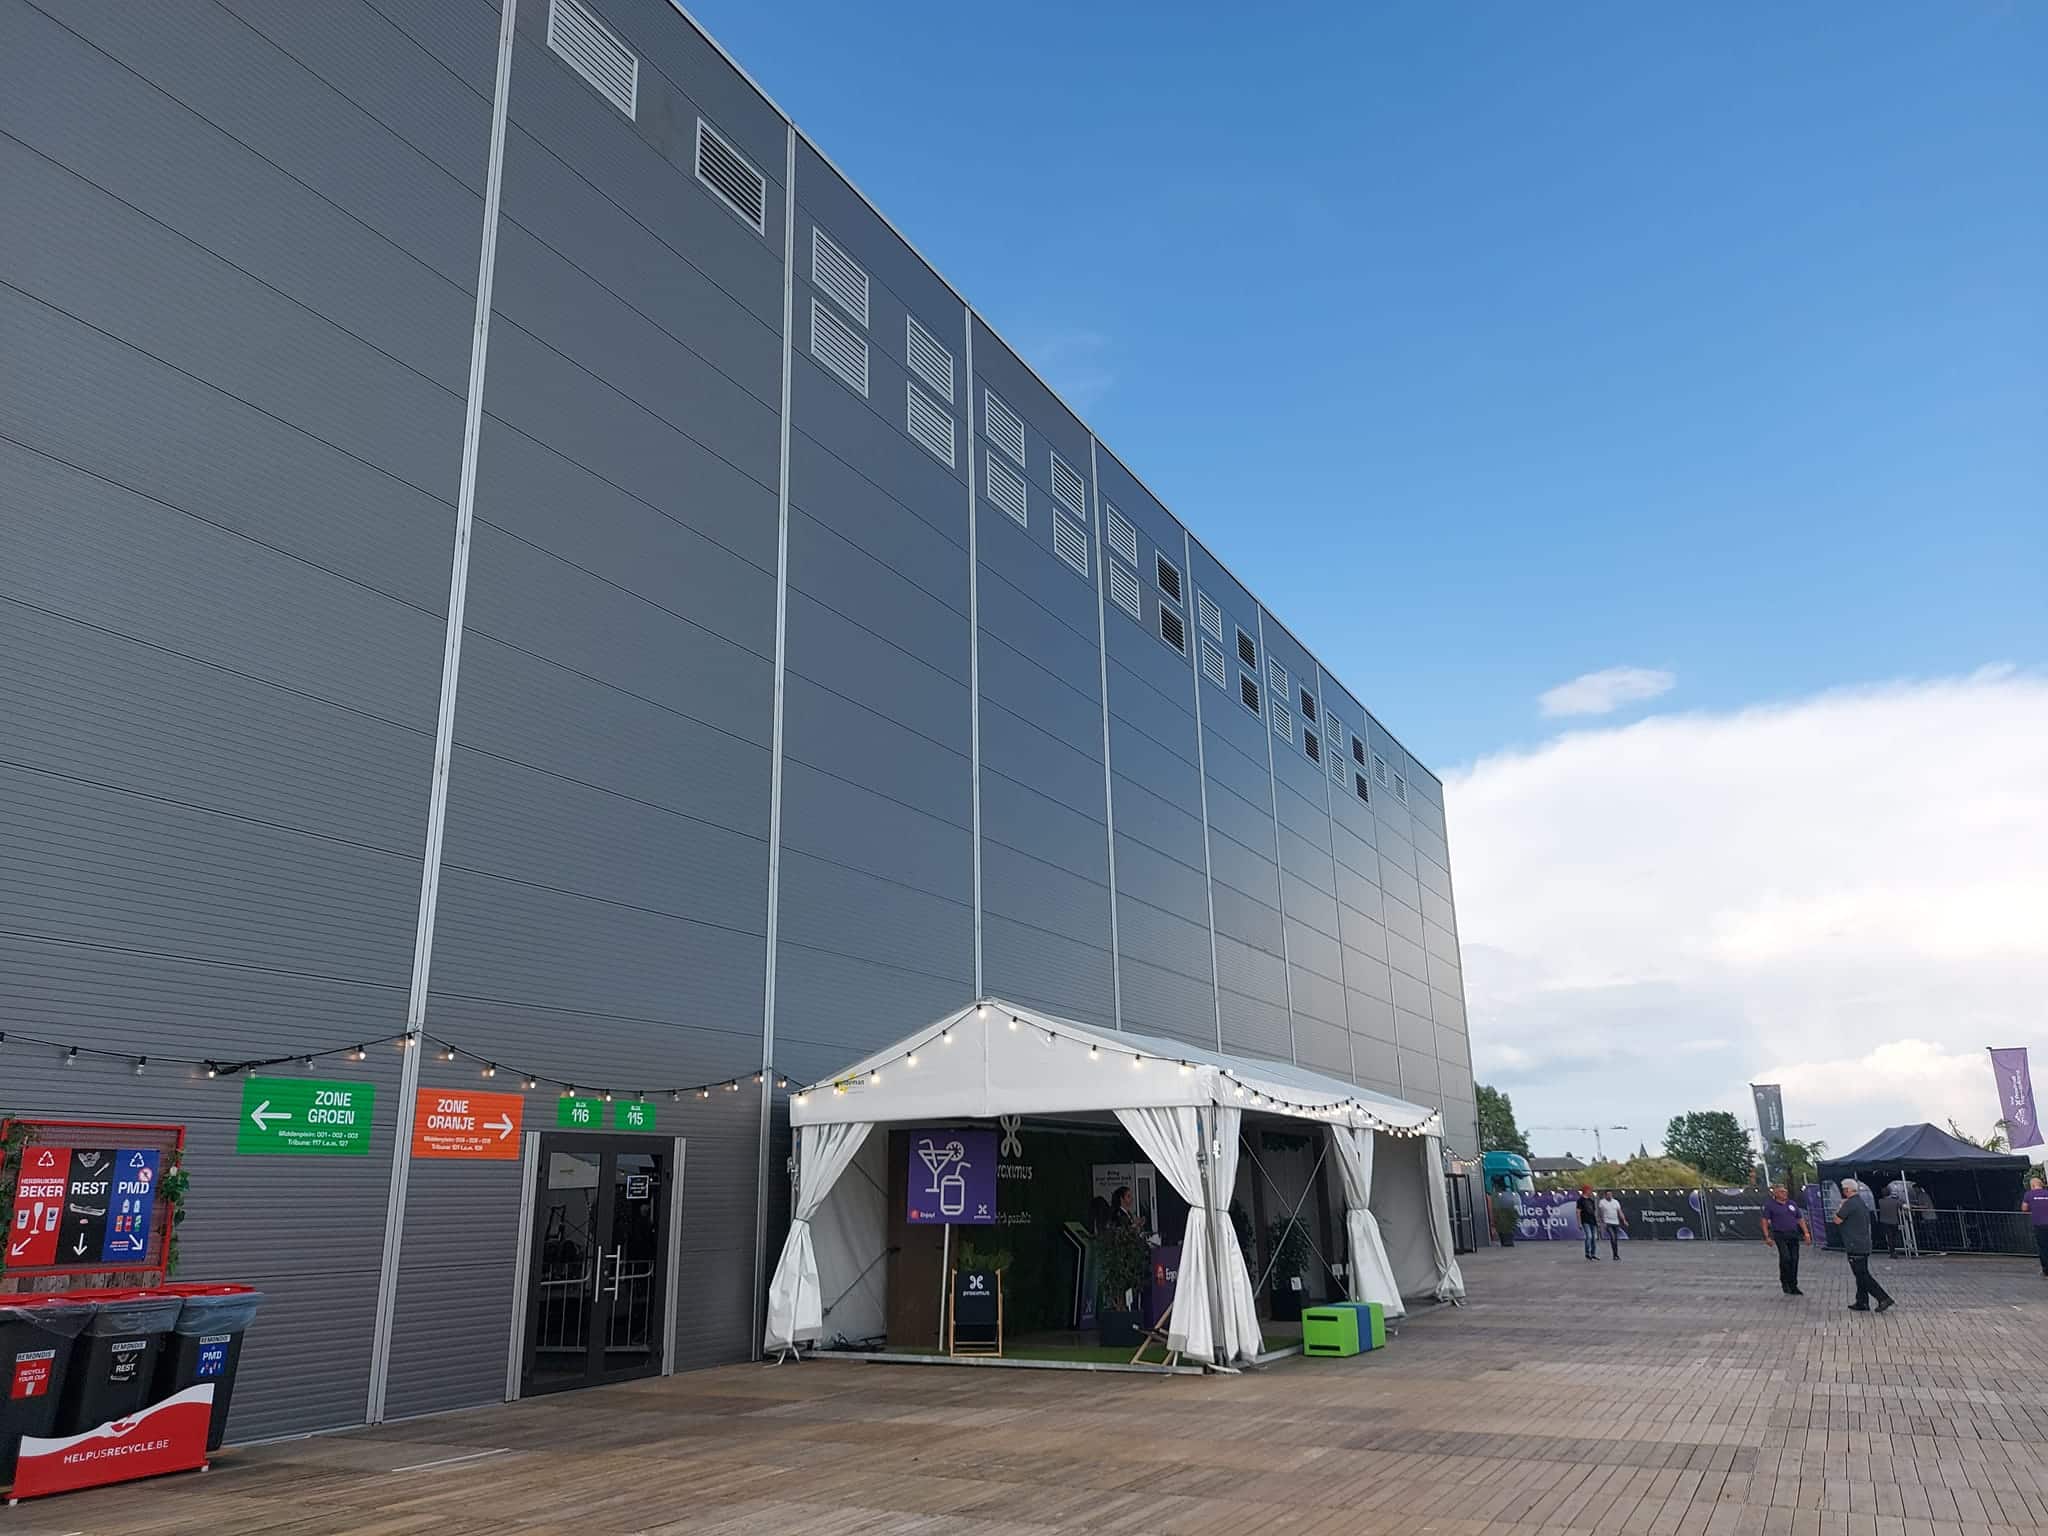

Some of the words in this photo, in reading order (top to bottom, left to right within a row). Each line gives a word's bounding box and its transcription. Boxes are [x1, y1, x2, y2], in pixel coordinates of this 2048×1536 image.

[315, 1090, 352, 1106] ZONE
[436, 1098, 469, 1114] ZONE
[307, 1108, 355, 1125] GROEN
[426, 1114, 476, 1131] ORANJE
[571, 1108, 590, 1123] 116
[627, 1111, 644, 1125] 115
[997, 1164, 1033, 1180] roximus
[19, 1185, 64, 1198] BEKER
[71, 1181, 109, 1195] REST
[118, 1181, 150, 1194] PMD
[1546, 1204, 1560, 1216] to
[1542, 1217, 1569, 1230] you
[203, 1350, 222, 1361] PMD
[20, 1367, 46, 1377] RECYCLE
[115, 1363, 135, 1373] REST
[63, 1439, 170, 1464] HELPUSRECYCLE.BE
